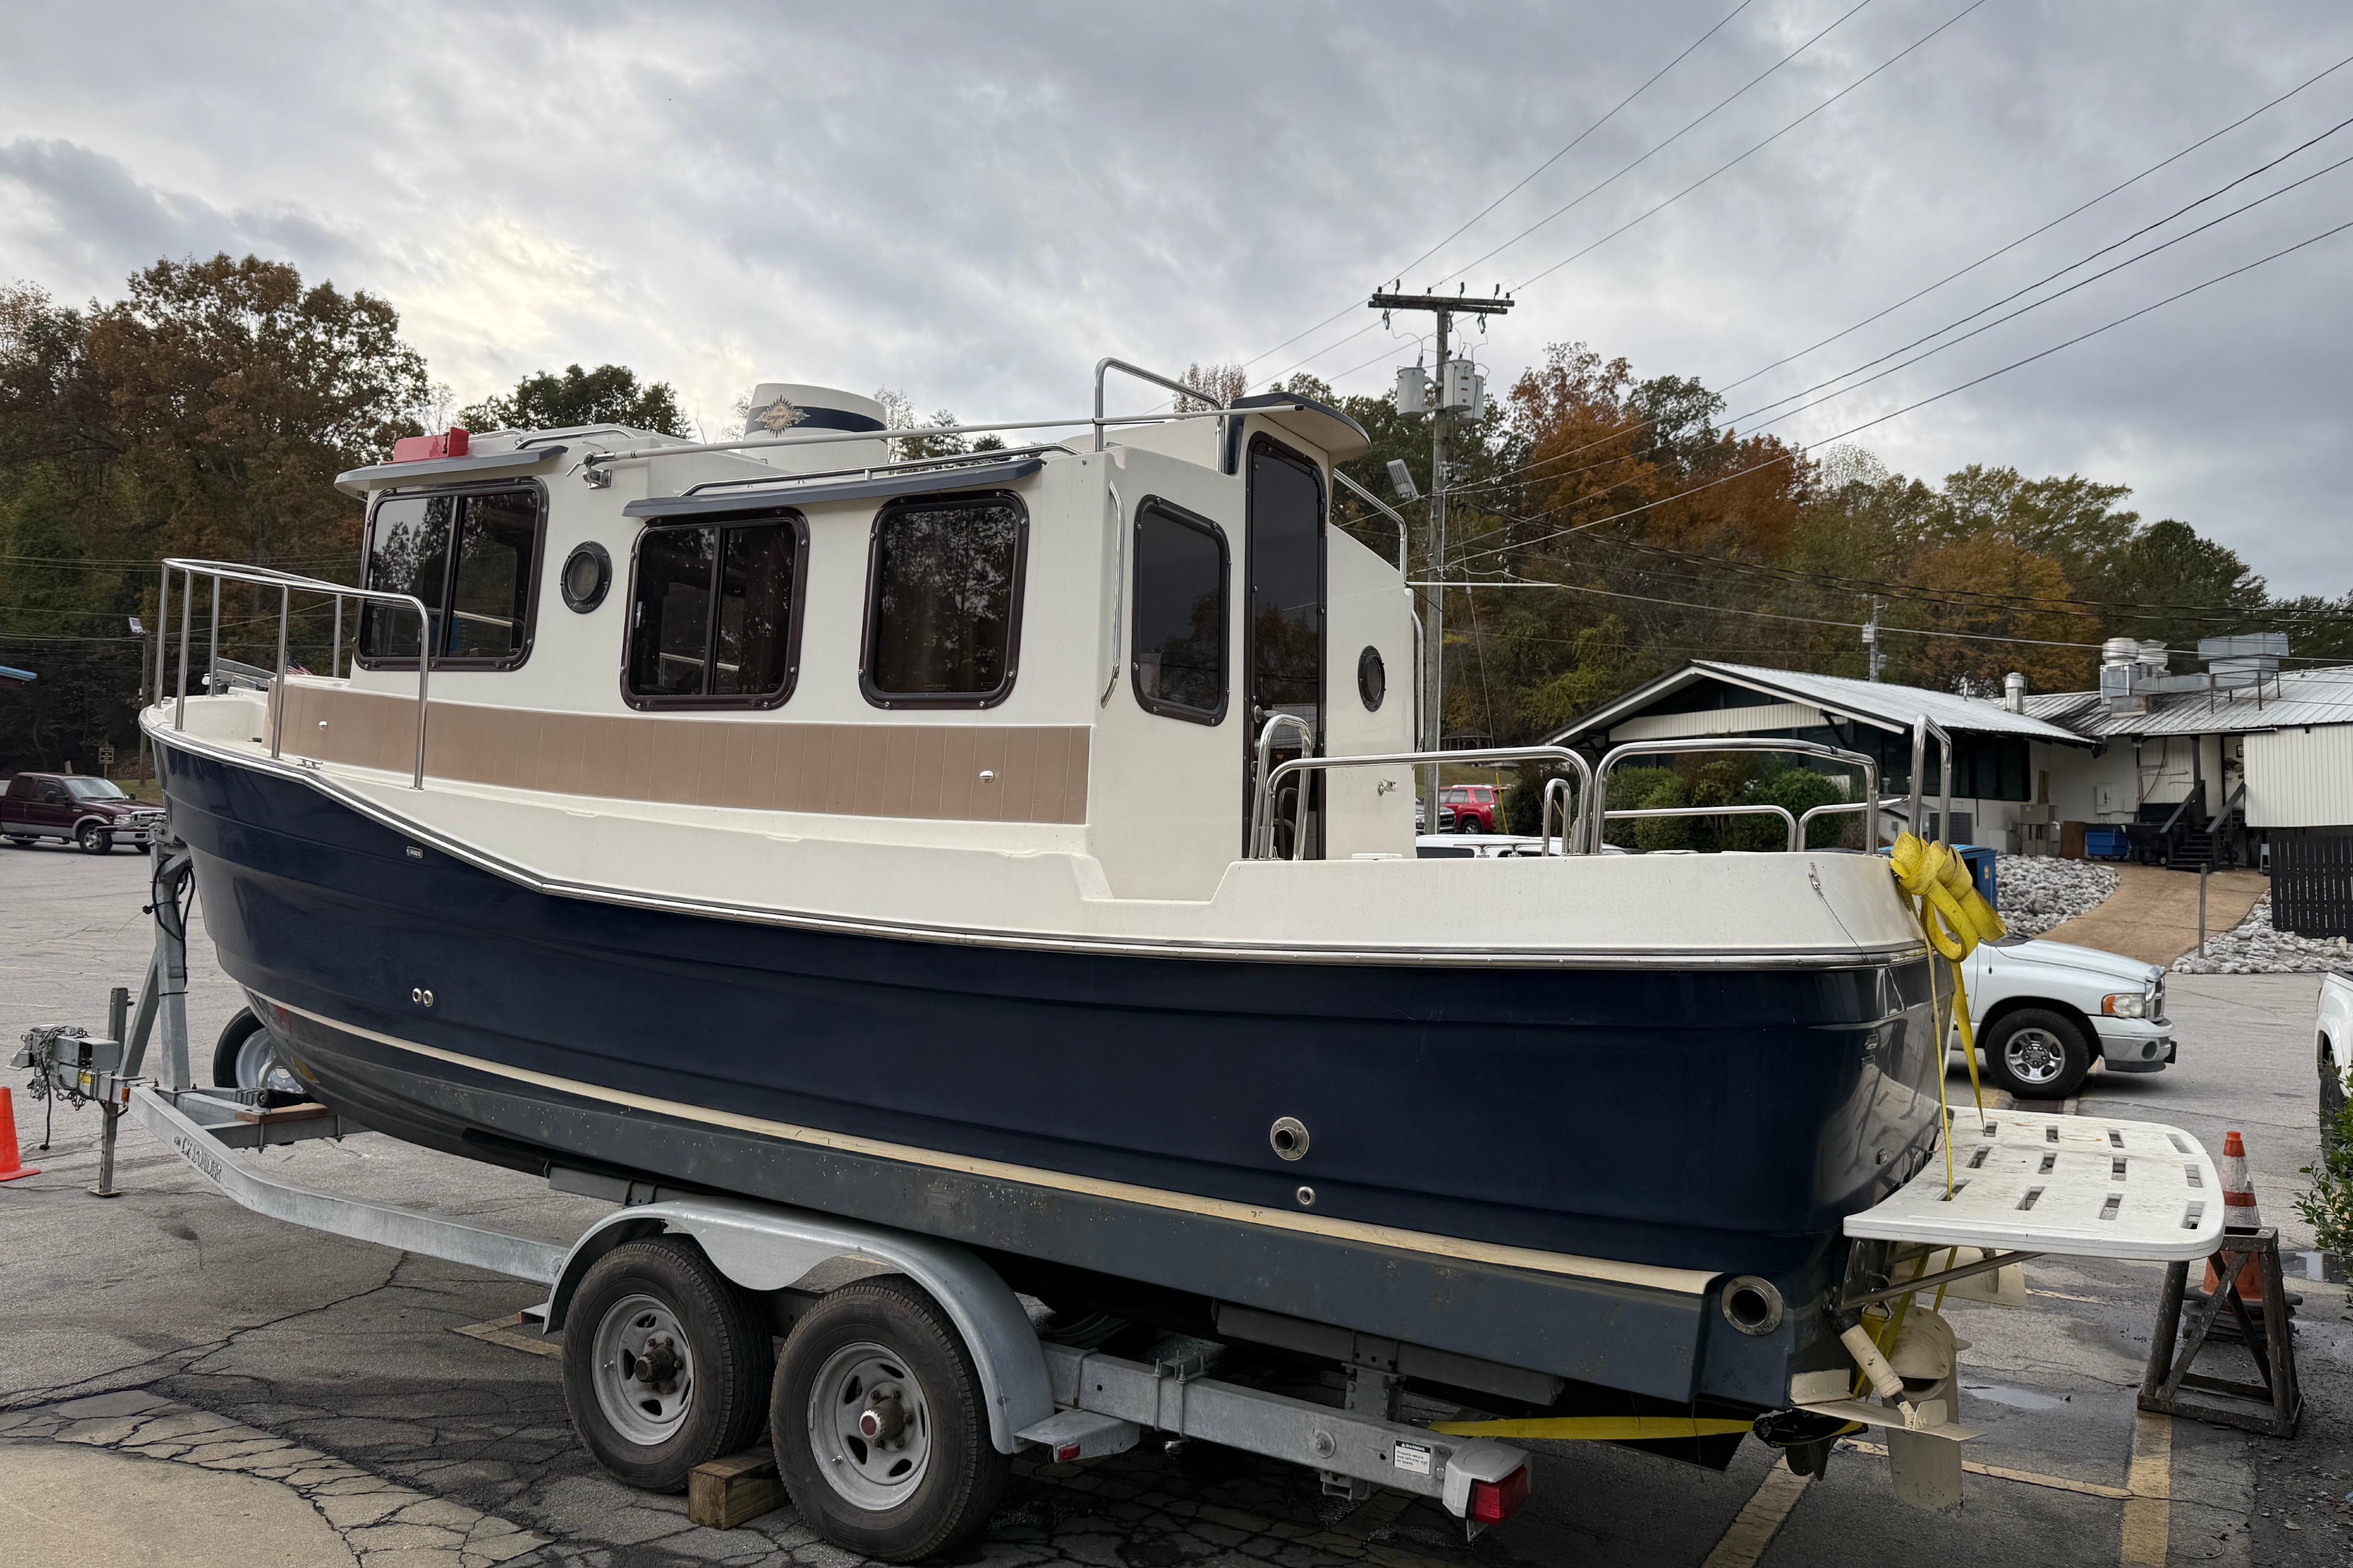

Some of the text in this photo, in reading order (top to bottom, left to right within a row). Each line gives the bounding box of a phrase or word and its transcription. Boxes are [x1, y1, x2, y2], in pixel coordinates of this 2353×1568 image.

[759, 409, 806, 424] Ranger Tugs
[1405, 1443, 1426, 1452] WARNING
